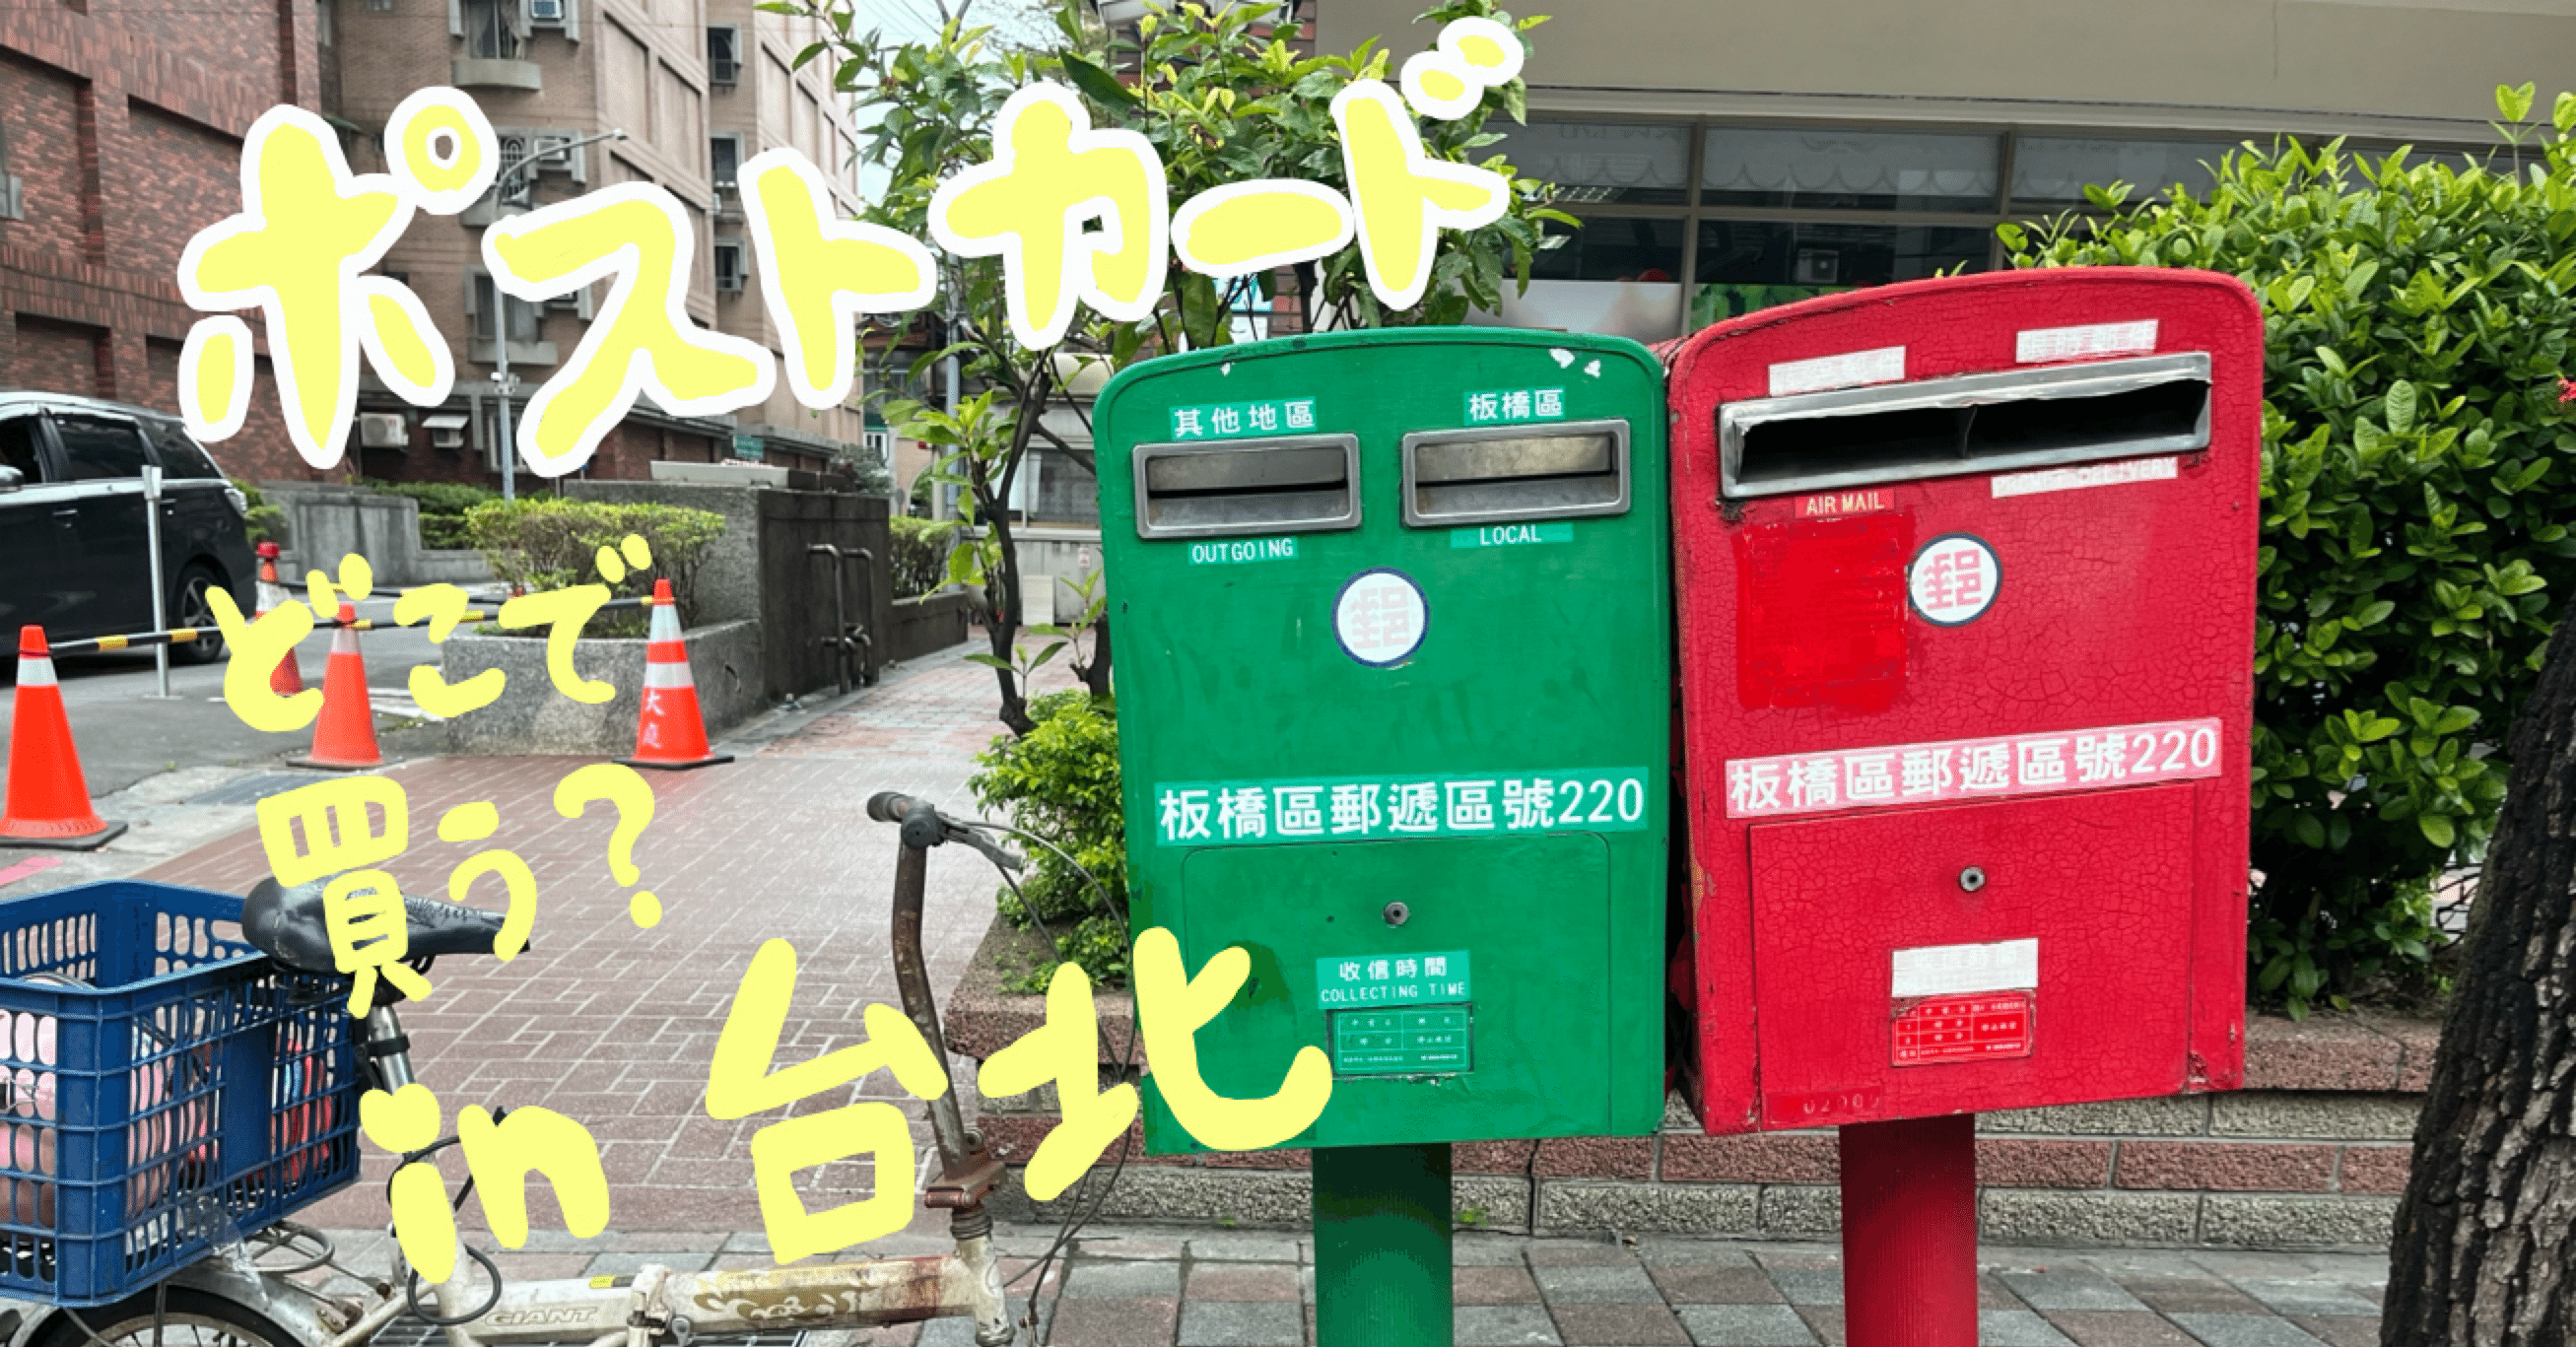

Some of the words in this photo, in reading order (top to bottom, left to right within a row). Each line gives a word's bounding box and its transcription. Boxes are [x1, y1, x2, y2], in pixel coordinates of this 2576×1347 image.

[1174, 399, 1316, 438] 其他地區
[1468, 388, 1565, 422] 板橋區
[1806, 496, 1837, 515] AIR
[1840, 491, 1885, 512] MAIL
[1479, 523, 1543, 547] LOCAL
[1190, 537, 1294, 564] OUTGOING
[1729, 726, 2217, 813] 板橋區郵遞區號220
[1159, 777, 1646, 842] 板橋區郵遞區號220
[1338, 955, 1449, 982] 收信時間
[1320, 984, 1419, 1003] COLLECTING
[1429, 980, 1466, 996] TIME
[484, 1306, 598, 1326] GIANT
